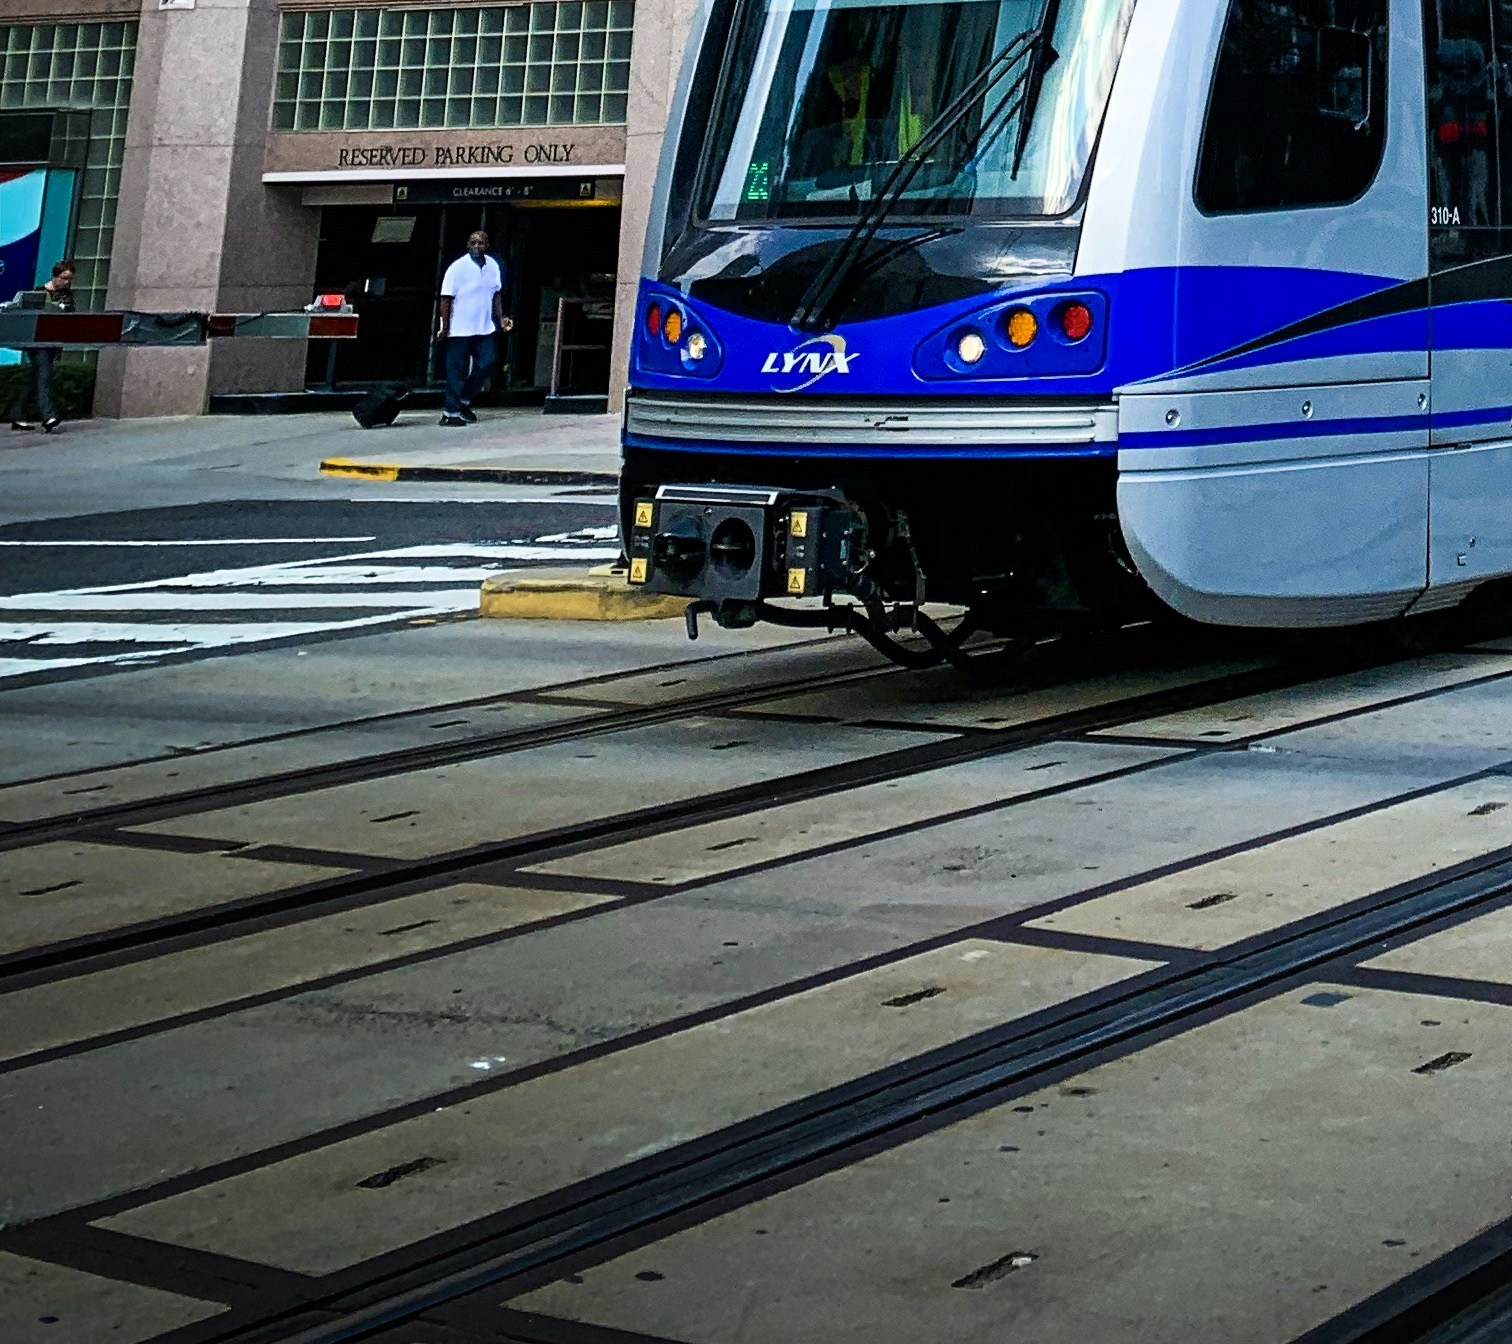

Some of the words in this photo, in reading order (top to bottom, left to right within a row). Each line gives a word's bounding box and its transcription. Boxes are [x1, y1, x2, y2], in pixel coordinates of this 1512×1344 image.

[338, 147, 427, 166] RESERVED
[434, 145, 514, 163] PARKING
[524, 144, 576, 162] ONLY
[452, 186, 503, 197] CLEARANCE
[1431, 206, 1461, 225] 310-A
[760, 352, 861, 374] LYNX
